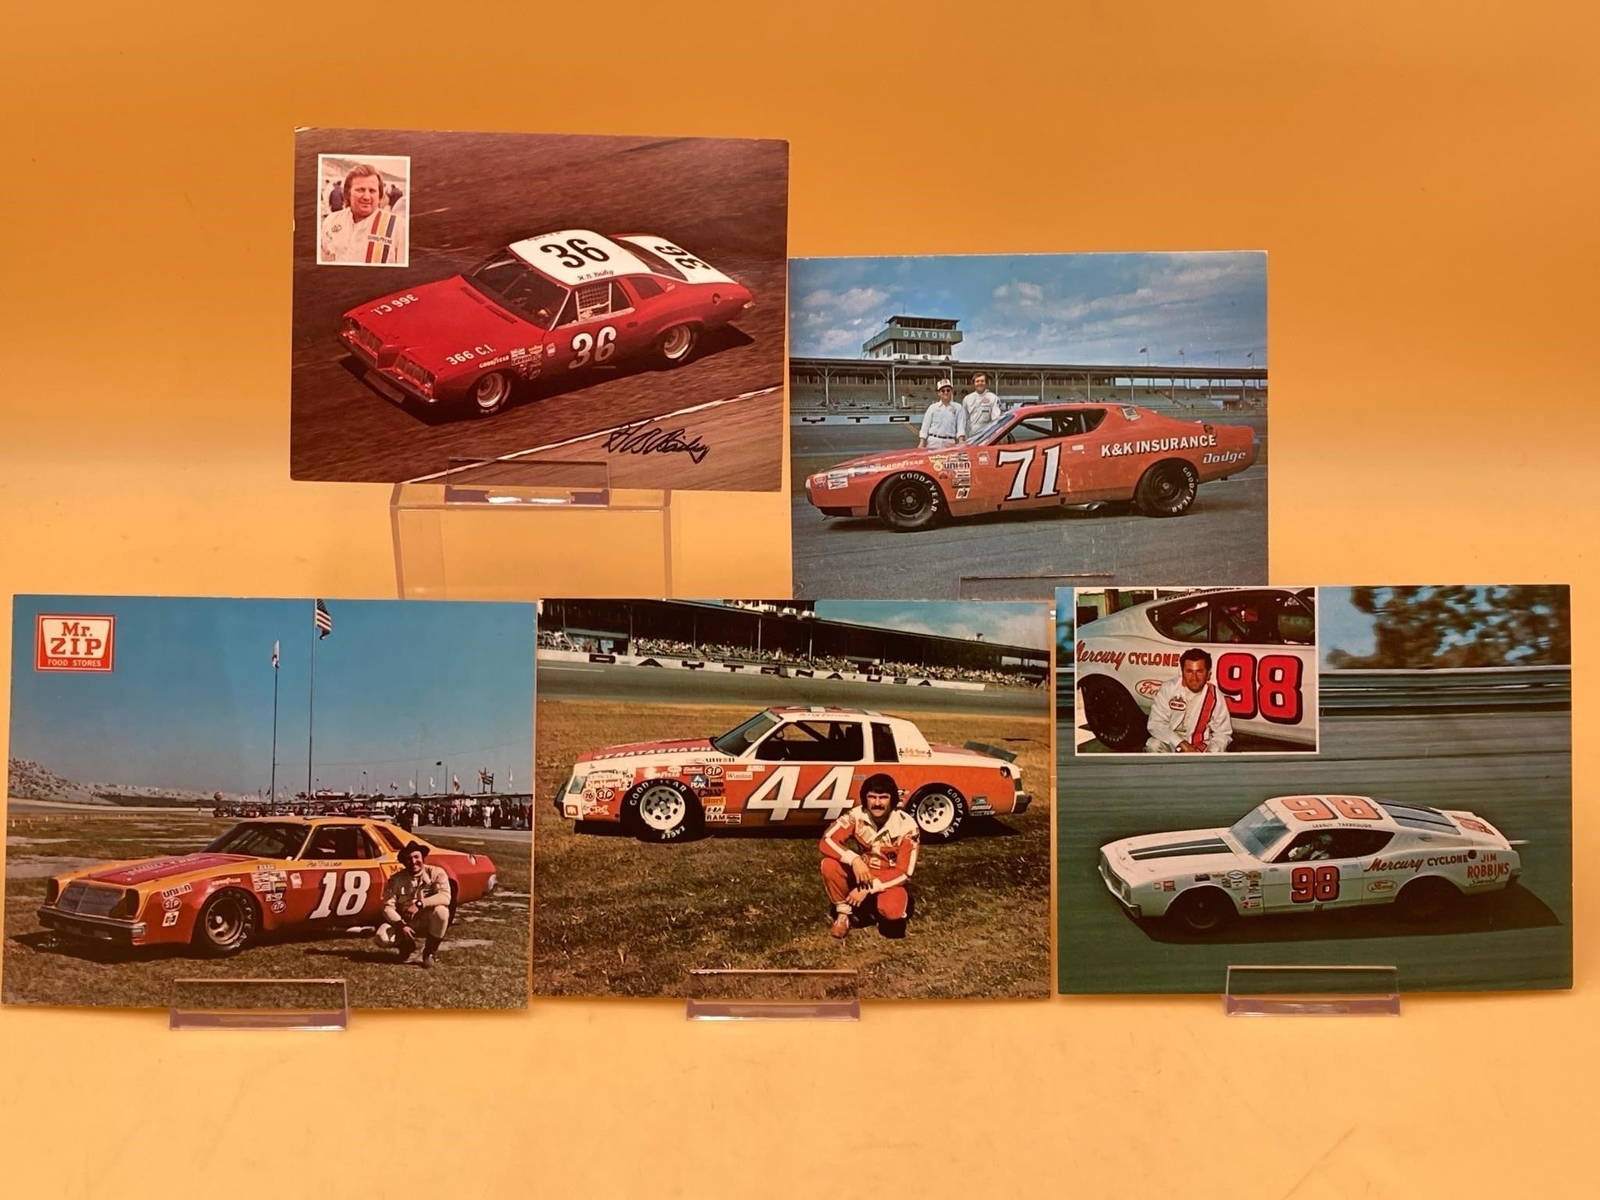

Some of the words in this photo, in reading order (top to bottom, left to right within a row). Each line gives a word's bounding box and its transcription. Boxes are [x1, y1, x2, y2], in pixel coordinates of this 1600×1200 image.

[540, 239, 610, 268] 36
[902, 329, 952, 340] DAYTONA
[568, 326, 618, 370] 36
[446, 350, 475, 366] 366
[1101, 443, 1136, 458] K&K
[1136, 434, 1218, 456] INSURANCE
[1202, 450, 1246, 464] Dodge
[996, 443, 1062, 501] 71
[61, 621, 93, 637] Mr.
[50, 637, 102, 656] ZIP
[48, 659, 69, 667] FOOD
[72, 659, 102, 668] STORES
[1128, 651, 1181, 667] CYCLONE
[1216, 652, 1303, 725] 98
[705, 766, 724, 777] STP
[746, 765, 855, 822] 44
[1281, 797, 1383, 821] 98
[1363, 858, 1425, 873] Mercury
[1427, 854, 1469, 867] CYCLONE
[1480, 853, 1497, 863] JIM
[1467, 862, 1510, 879] ROBBINS
[163, 885, 192, 899] union
[1291, 865, 1340, 904] 98
[309, 869, 371, 920] 18
